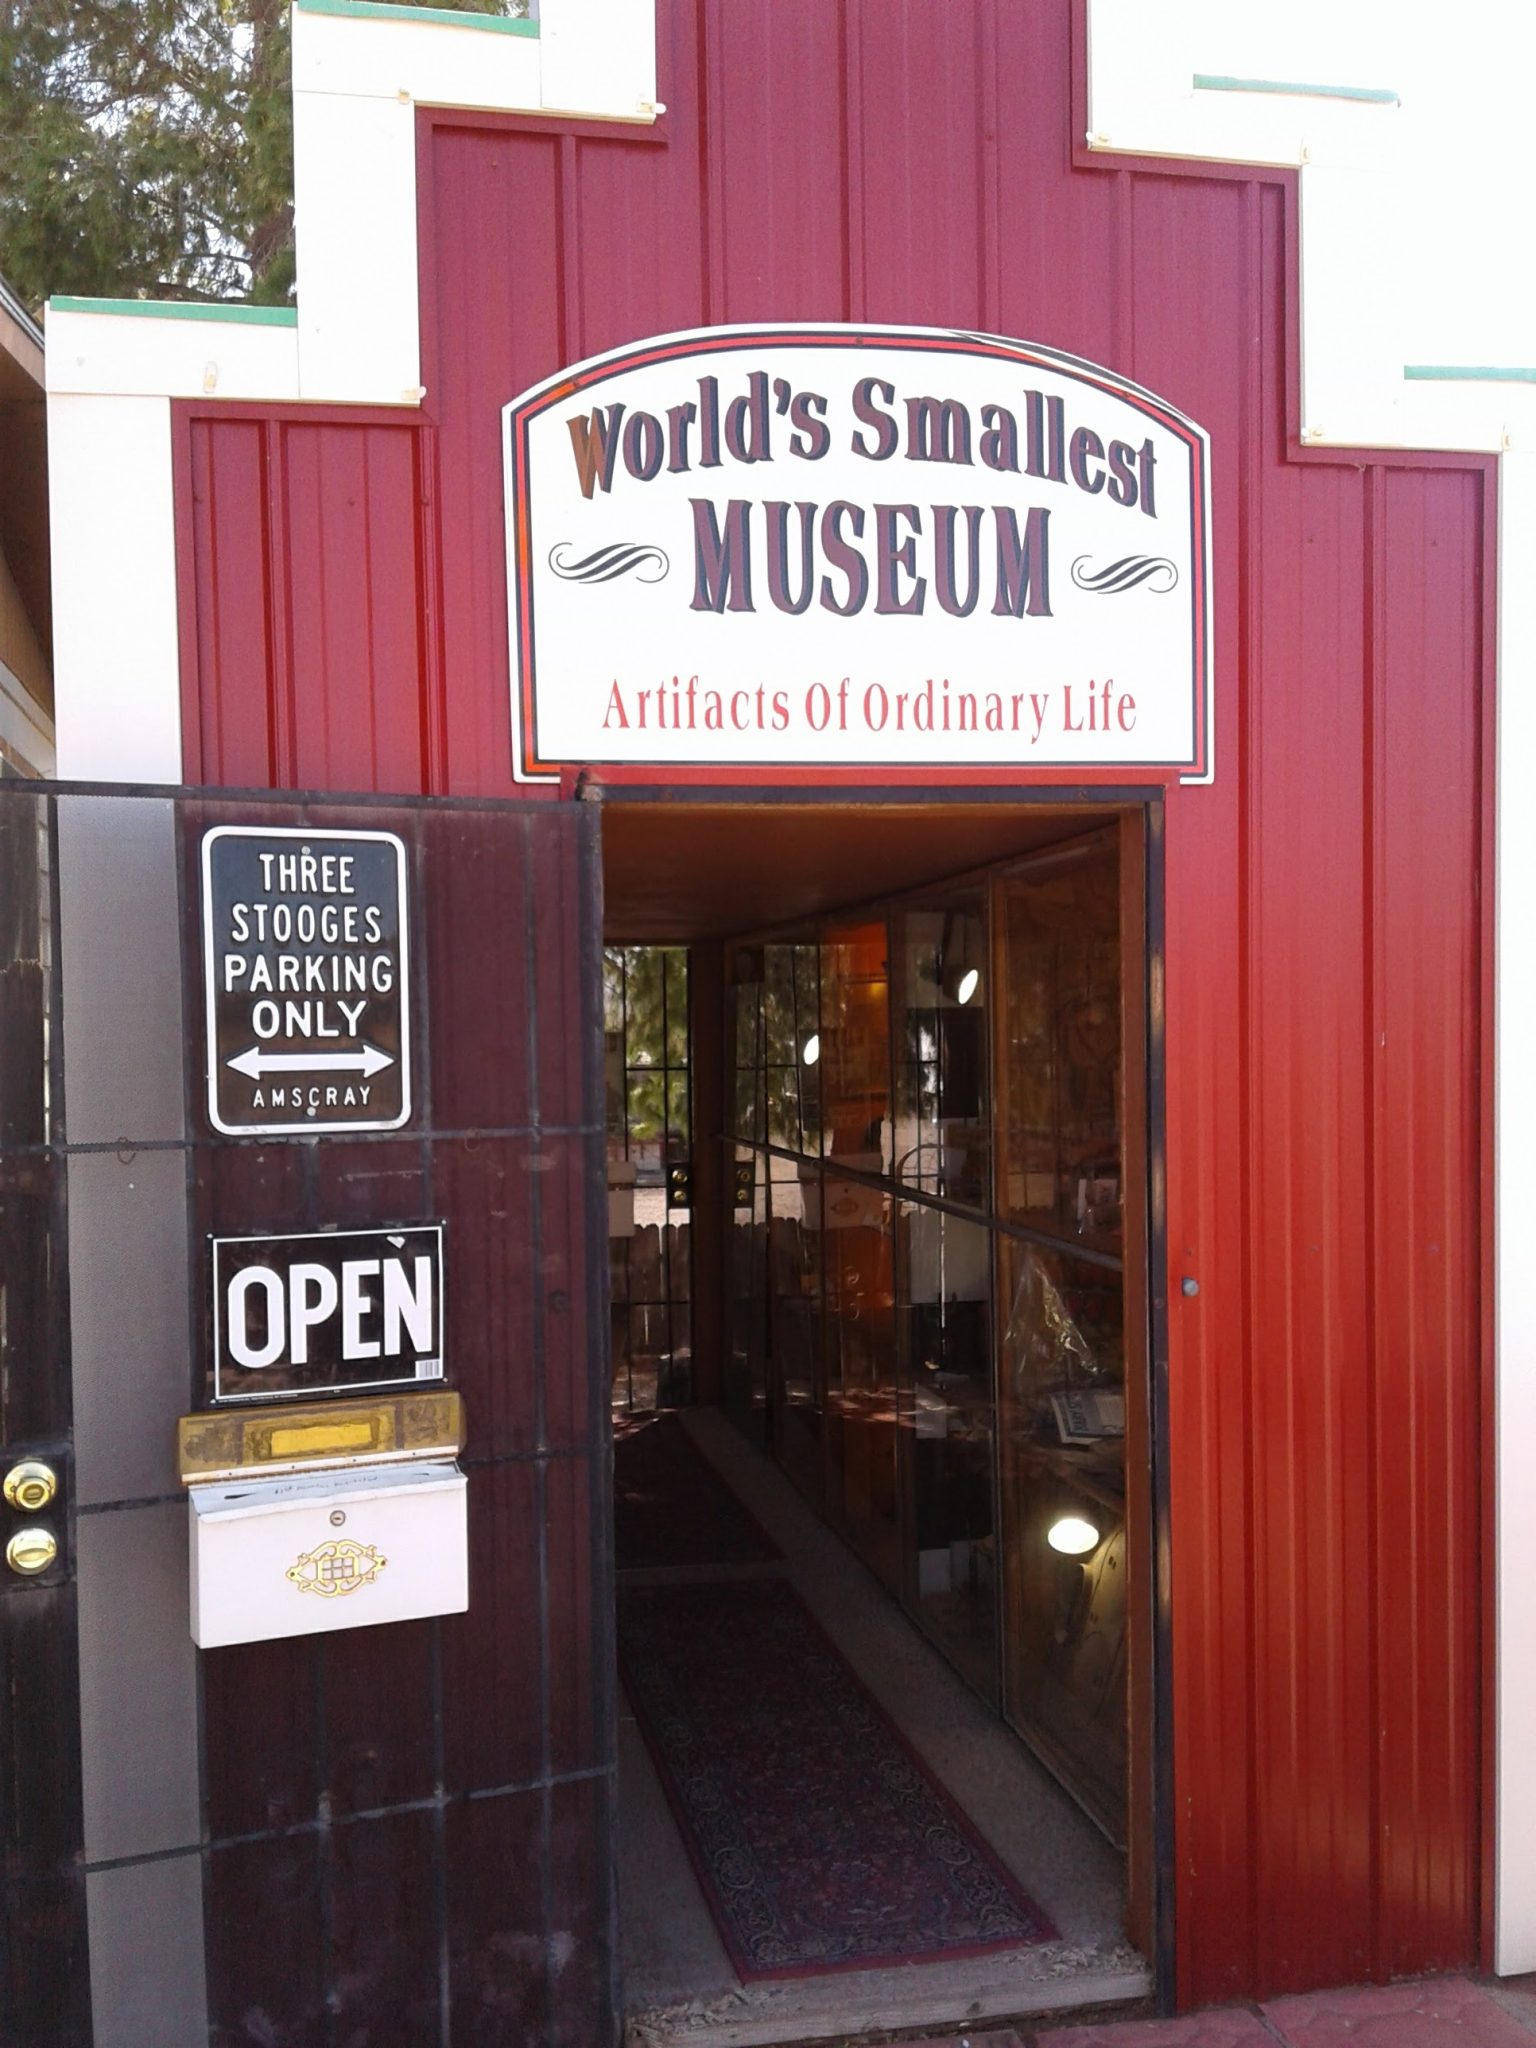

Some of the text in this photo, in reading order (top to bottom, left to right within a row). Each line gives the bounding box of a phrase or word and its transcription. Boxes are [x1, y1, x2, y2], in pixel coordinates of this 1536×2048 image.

[566, 371, 1158, 519] World's Smallest
[688, 497, 1055, 619] MUSEUM
[602, 675, 1137, 745] Artifacts Of Ordinary Life
[259, 853, 355, 893] THREE
[231, 903, 382, 943] STOOGES
[224, 954, 393, 993] PARKING
[252, 1000, 367, 1038] ONLY
[253, 1086, 371, 1108] AMSCRAY
[227, 1256, 433, 1369] OPEN
